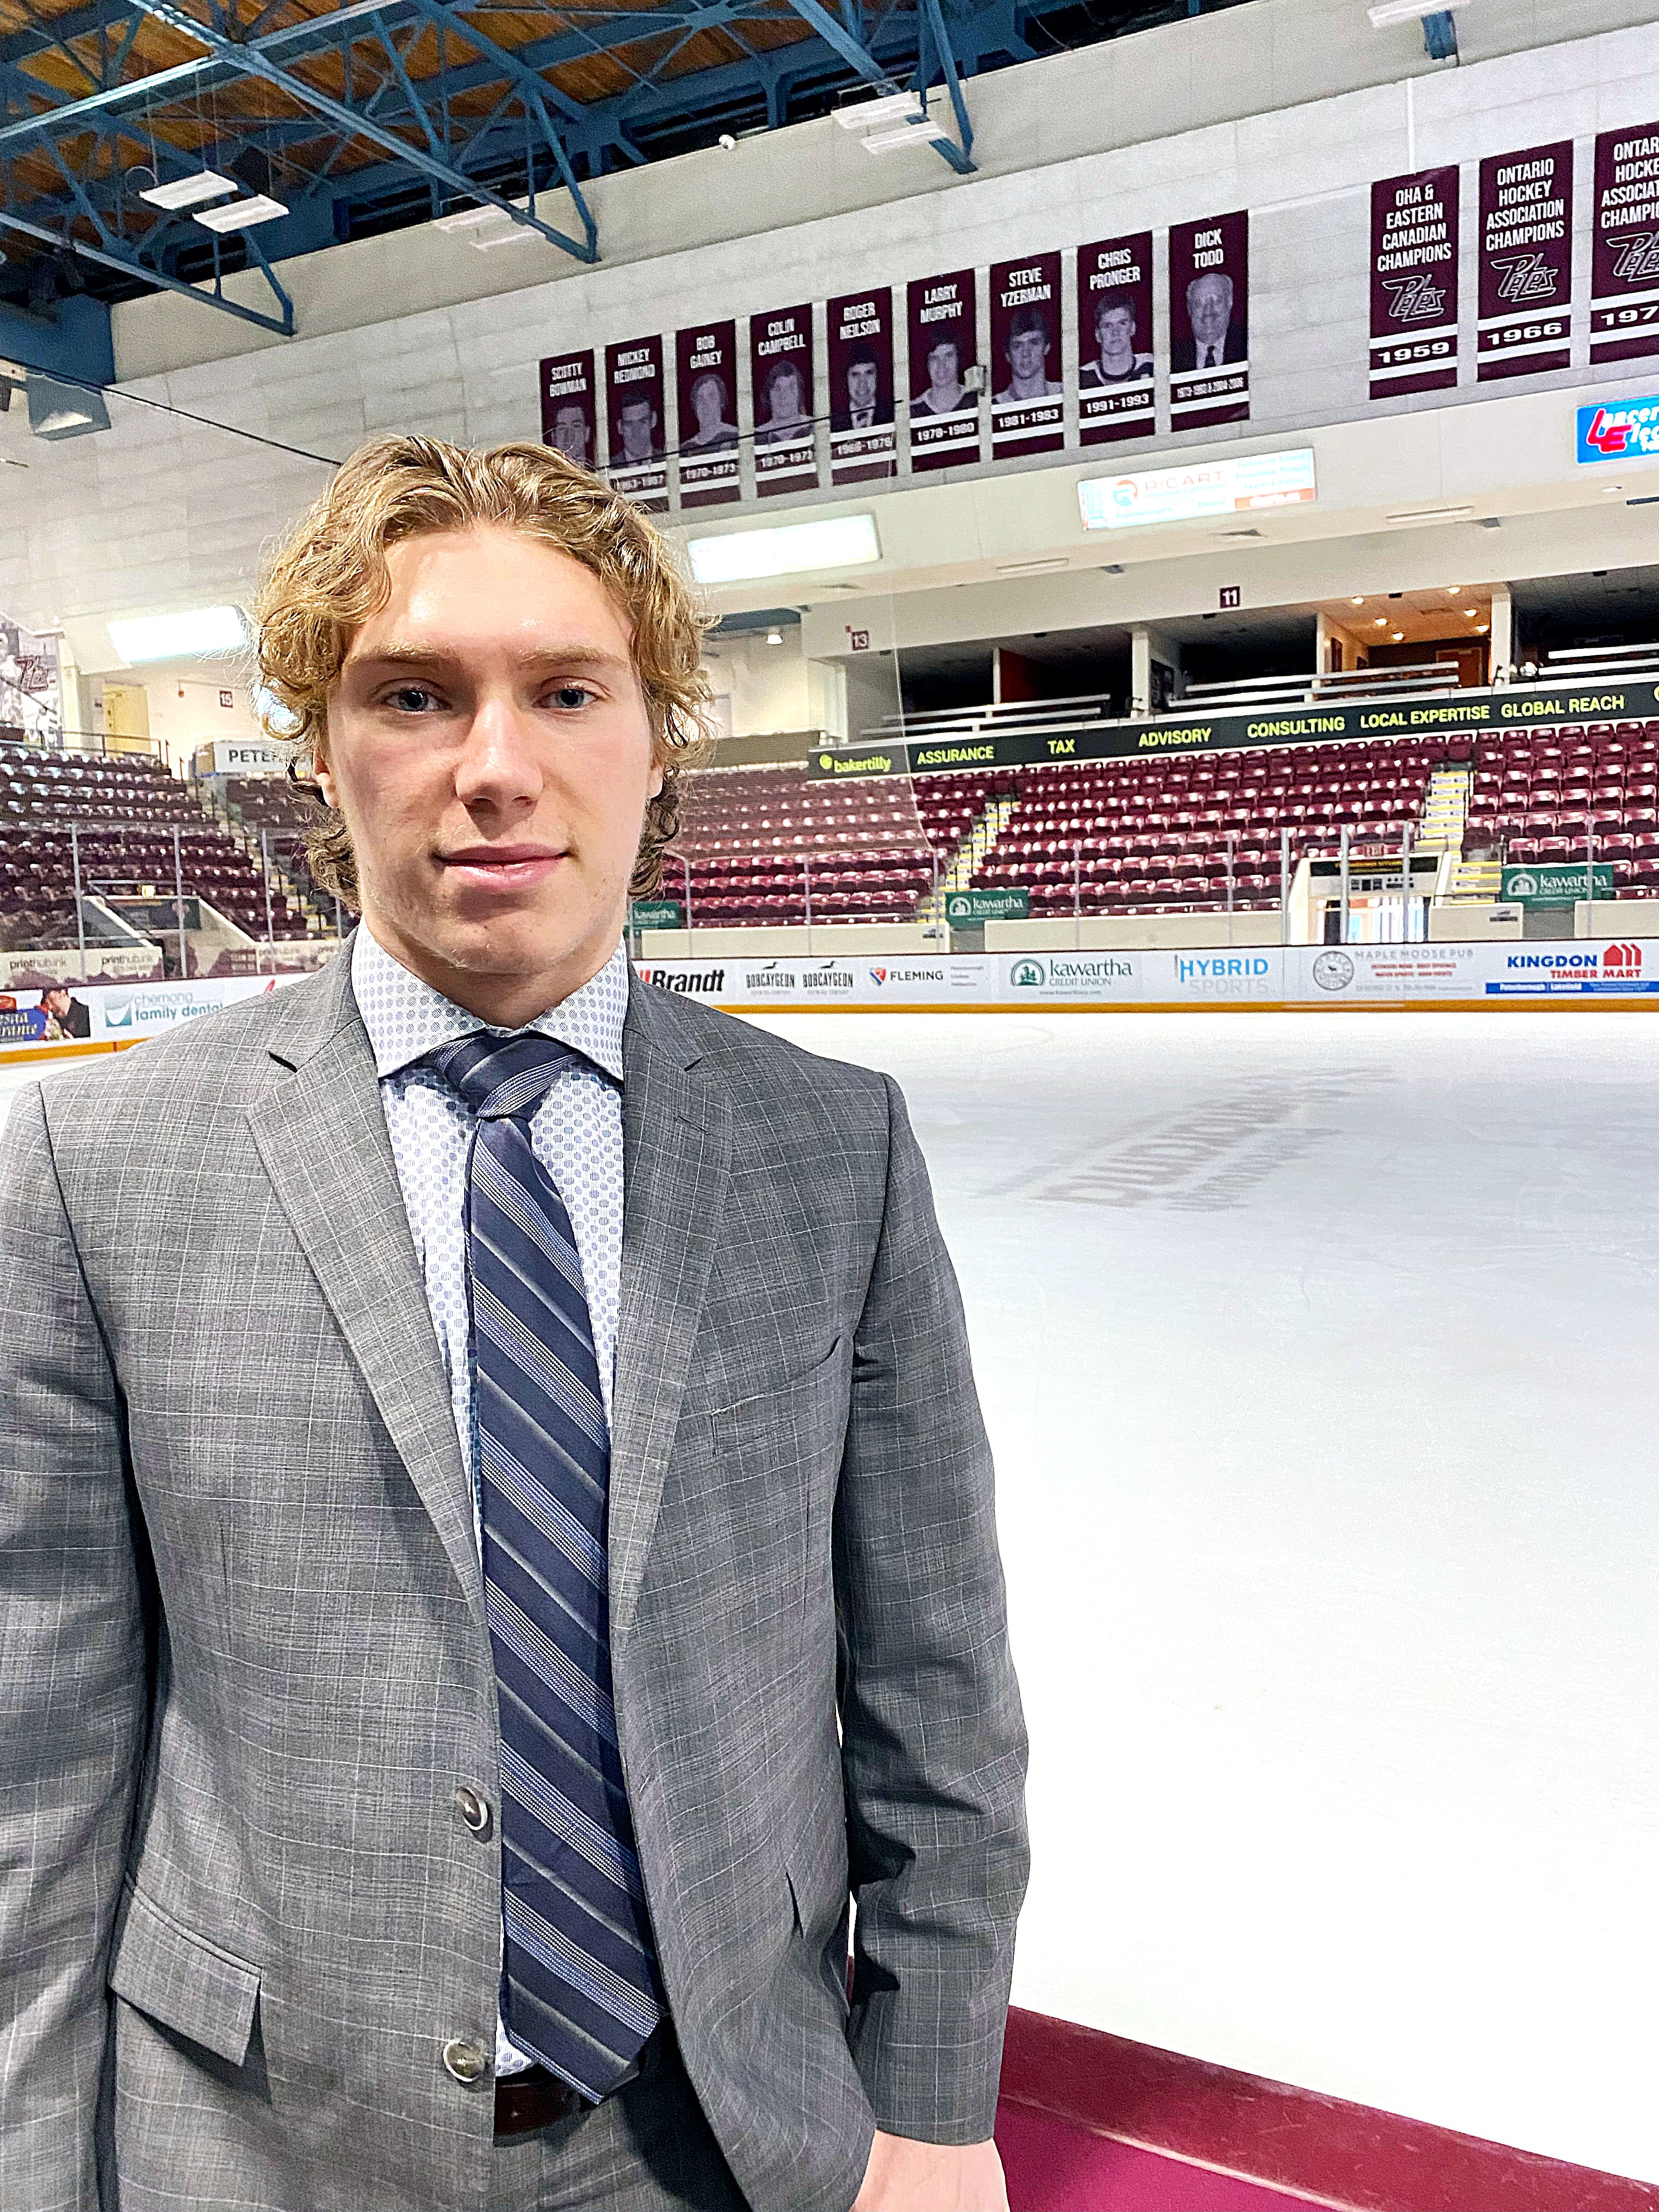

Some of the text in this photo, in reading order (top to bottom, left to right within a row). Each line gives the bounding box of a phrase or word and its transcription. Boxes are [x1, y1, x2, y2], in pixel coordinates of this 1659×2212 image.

[1613, 137, 1659, 161] ONTAR
[1497, 158, 1554, 185] ONTARIO
[1615, 157, 1659, 183] HOCKE
[1396, 184, 1434, 206] OHA &
[1499, 179, 1552, 207] HOCKEY
[1386, 202, 1443, 229] EASTERN
[1486, 199, 1564, 230] ASSOCIATION
[1194, 229, 1222, 248] DICK
[1383, 222, 1447, 251] CANADIAN
[1486, 220, 1564, 251] CHAMPIONS
[1098, 248, 1132, 269] CHRIS
[1193, 248, 1224, 269] TODD
[1377, 242, 1452, 272] CHAMPIONS
[1008, 268, 1043, 287] STEVE
[1090, 266, 1141, 290] PRONGER
[924, 284, 957, 304] LARRY
[1001, 284, 1051, 308] YZERMAN
[921, 301, 962, 324] MURPHY
[1600, 306, 1659, 326] 197
[768, 318, 794, 336] COLIN
[1486, 323, 1562, 346] 1966
[758, 333, 806, 355] CAMPBELL
[1378, 342, 1449, 363] 1959
[1086, 393, 1149, 413] 1991-1993
[1144, 471, 1224, 491] RICART
[1222, 589, 1237, 605] 11
[853, 633, 867, 647] 13
[917, 745, 994, 765] ASSURANCE
[1047, 738, 1075, 755] TAX
[1138, 727, 1211, 748] ADVISORY
[1247, 717, 1346, 739] CONSULTING
[1361, 712, 1407, 729] LOCAL
[1410, 705, 1491, 726] EXPERTISE
[1501, 699, 1565, 719] GLOBAL
[1570, 695, 1625, 712] REACH
[229, 749, 282, 763] PETE
[973, 895, 1023, 909] kawartha
[1355, 949, 1474, 959] MAPLE MOOSE PUB
[1508, 954, 1598, 968] KINGDON
[890, 970, 943, 981] FLEMING
[1050, 959, 1132, 976] kawartha
[1180, 958, 1268, 983] HYBRID
[1550, 969, 1642, 978] TIMBER MART
[652, 969, 724, 992] Brandt
[746, 973, 795, 988] BOBCAYGEON
[803, 972, 853, 988] BOBCAYGEON
[1049, 978, 1111, 986] CREDIT UNION
[1190, 978, 1268, 994] SPORTS
[134, 991, 192, 1006] chemong
[136, 1006, 177, 1021] family
